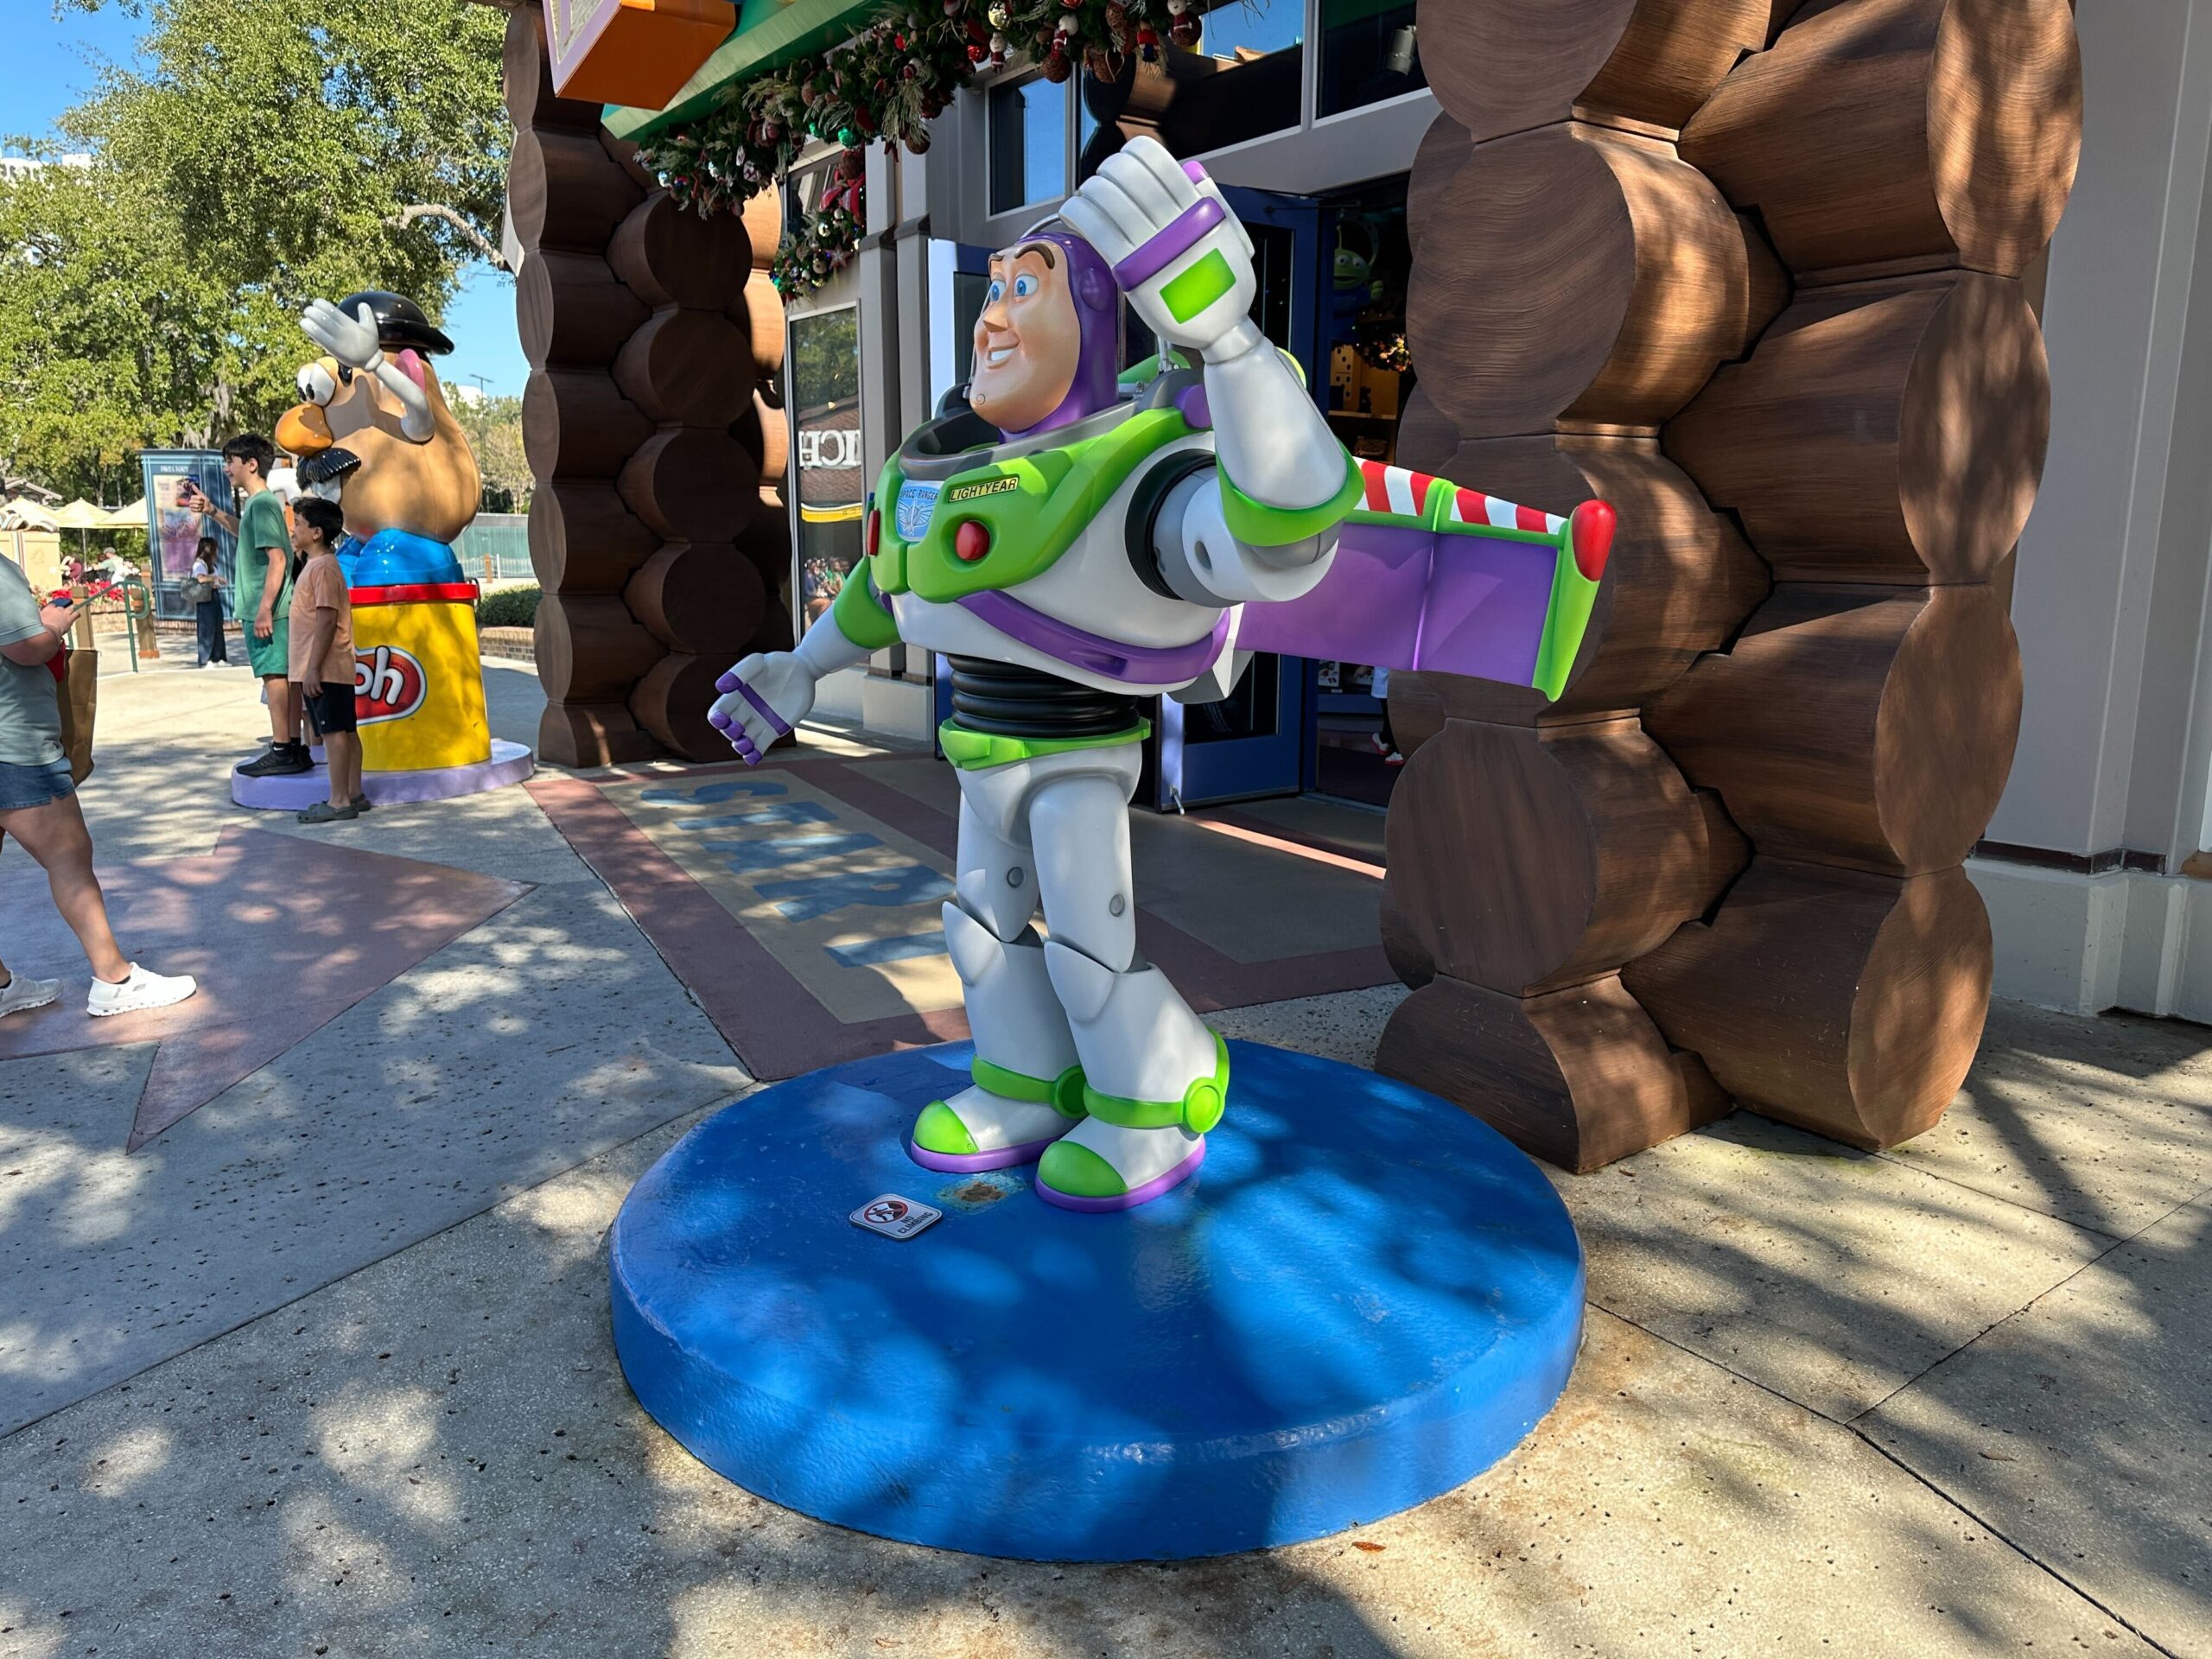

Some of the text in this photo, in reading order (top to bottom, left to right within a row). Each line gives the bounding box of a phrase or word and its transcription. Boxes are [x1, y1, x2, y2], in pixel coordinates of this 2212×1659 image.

[899, 488, 917, 499] SPACE
[950, 478, 1017, 500] LIGHTYEAR
[897, 1211, 933, 1234] CLIMBING
[899, 1216, 914, 1224] NO
